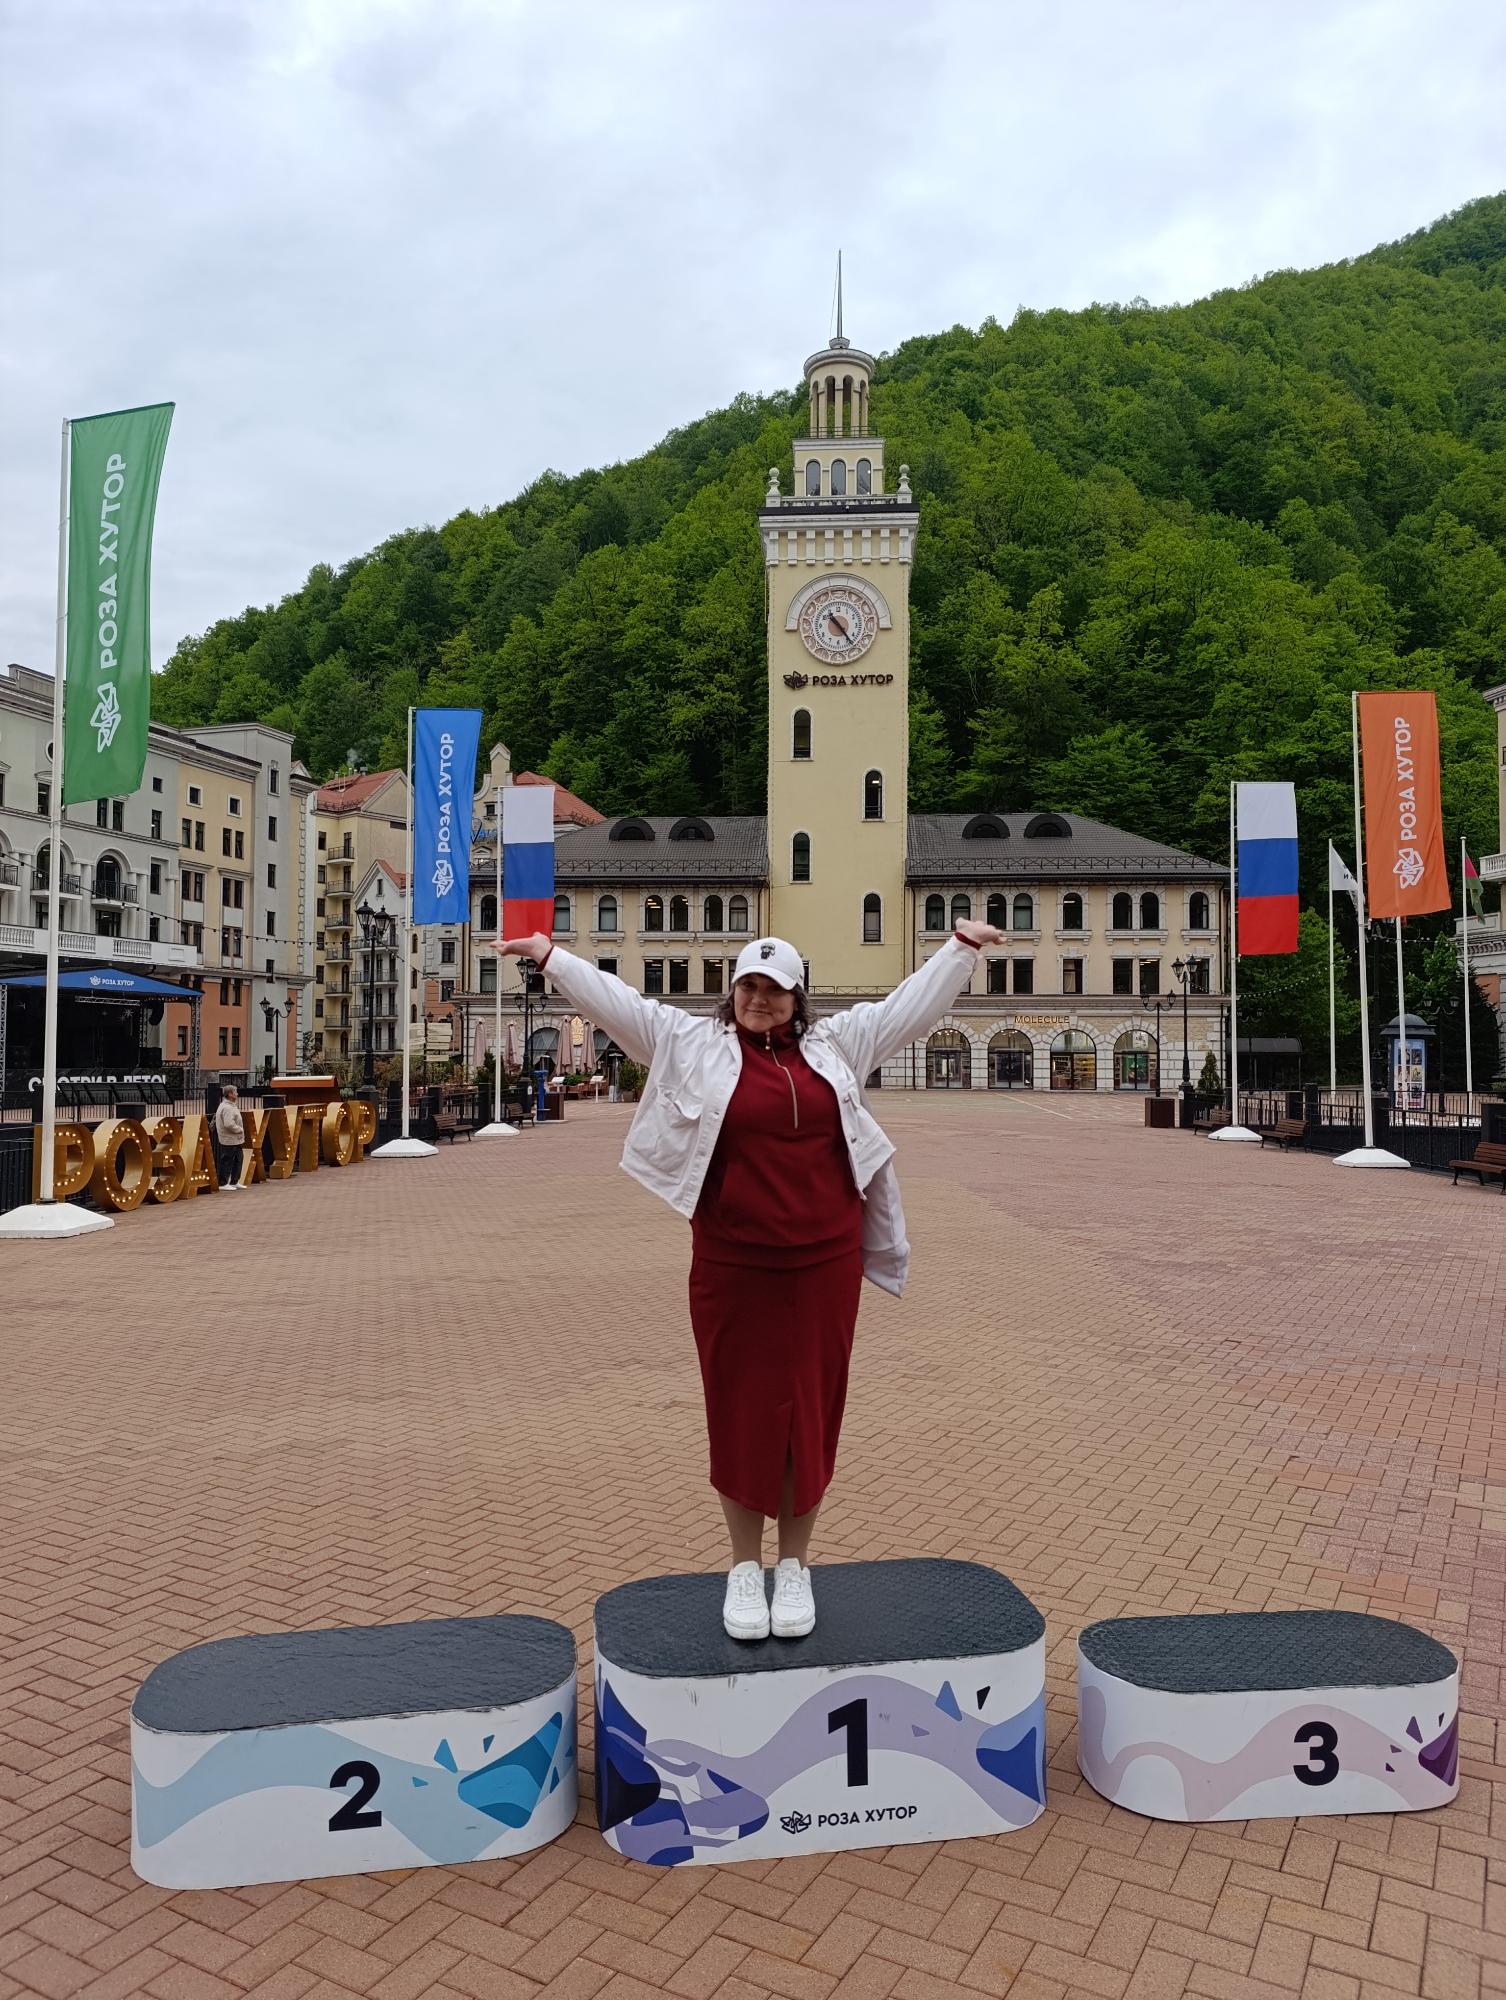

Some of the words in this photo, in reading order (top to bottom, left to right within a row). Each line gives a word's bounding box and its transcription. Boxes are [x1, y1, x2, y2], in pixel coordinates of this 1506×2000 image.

[98, 453, 127, 566] ХУТОР
[98, 572, 118, 669] РОЗА
[812, 675, 847, 686] РОЗА
[850, 674, 894, 685] ХУТОР
[438, 733, 455, 797] ХУТОР
[1394, 716, 1414, 782] ХУТОР
[437, 801, 452, 853] РОЗА
[1398, 786, 1417, 841] РОЗА
[1014, 1015, 1070, 1024] MOLECULE
[32, 1114, 219, 1212] РОЗА
[241, 1100, 377, 1185] ХУТОР
[828, 1698, 868, 1788] 1
[1293, 1721, 1339, 1786] 3
[328, 1760, 382, 1832] 2
[818, 1811, 861, 1828] РОЗА
[864, 1805, 918, 1823] ХУТОР
